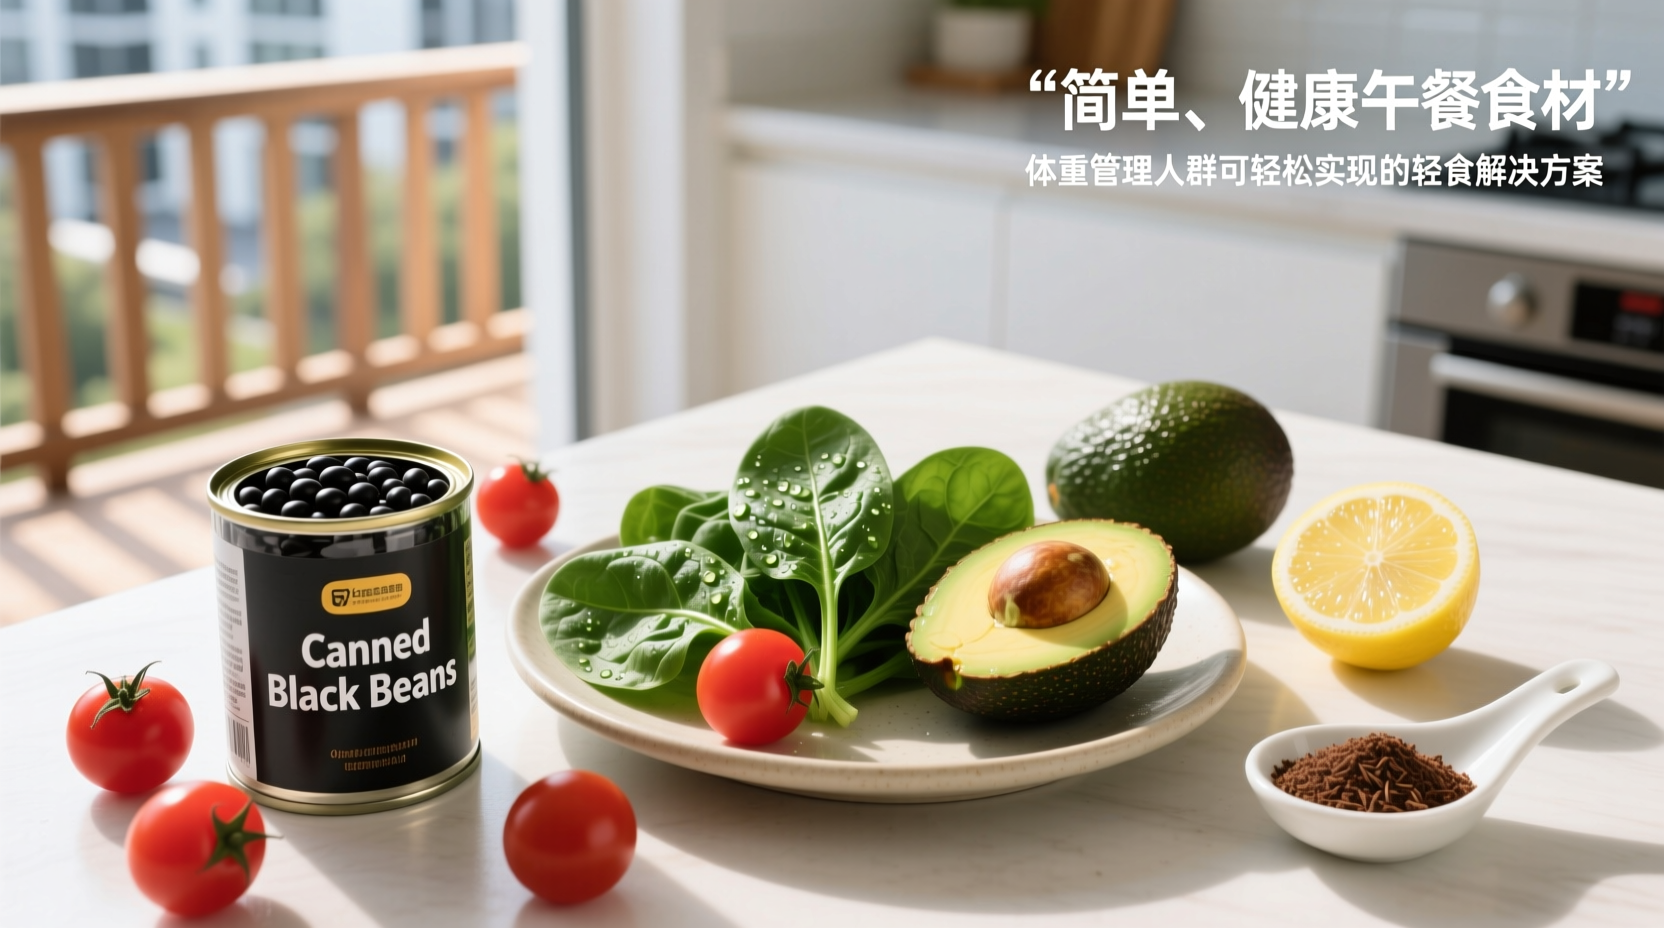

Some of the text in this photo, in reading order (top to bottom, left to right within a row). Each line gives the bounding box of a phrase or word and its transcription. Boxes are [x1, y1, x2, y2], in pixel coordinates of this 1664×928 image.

[302, 617, 431, 668] Canned
[268, 674, 360, 712] Black
[370, 659, 457, 708] Beans
